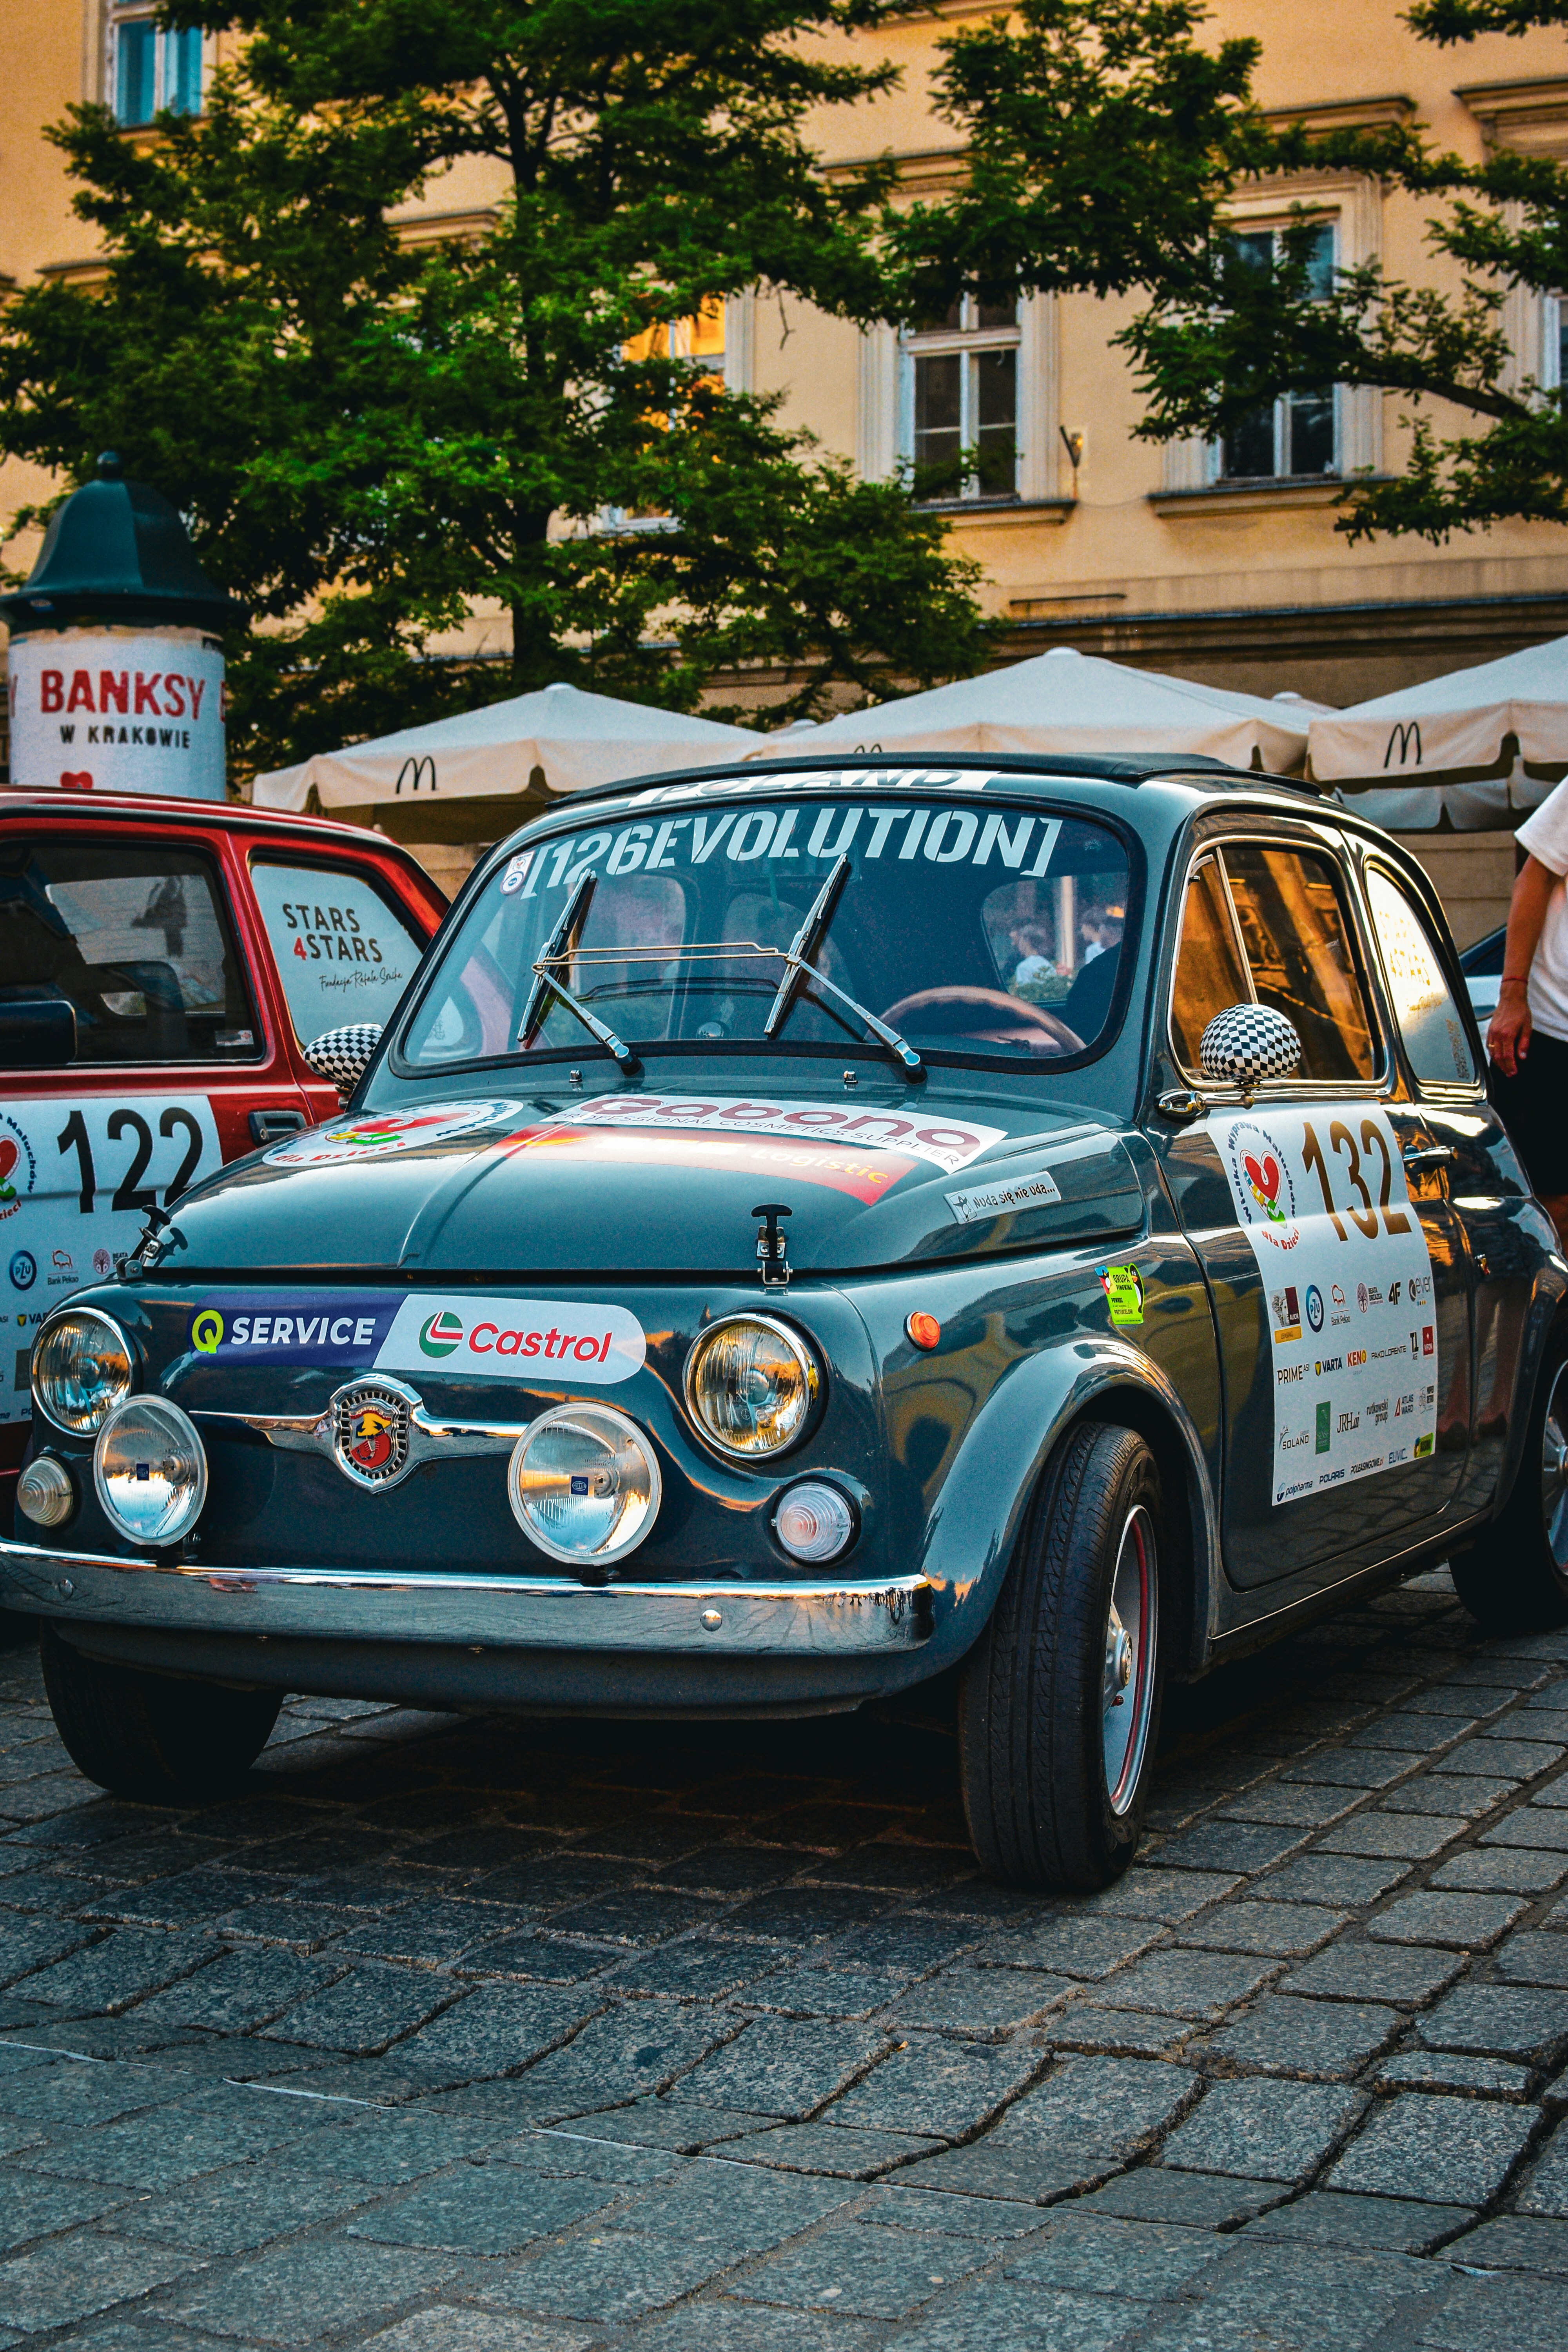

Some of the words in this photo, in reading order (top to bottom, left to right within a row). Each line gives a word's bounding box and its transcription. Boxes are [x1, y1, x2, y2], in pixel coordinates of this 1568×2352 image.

[41, 670, 205, 720] BANKSY
[60, 725, 75, 744] W
[88, 726, 190, 749] KRAKOWIE
[282, 903, 360, 933] STARS
[293, 934, 382, 963] 4STARS
[580, 1098, 980, 1157] Gabona
[1228, 1122, 1259, 1151] Wyprawa
[552, 1114, 711, 1125] PROFESSIONAL
[719, 1120, 849, 1136] COSMETICS
[849, 1133, 959, 1166] SUPPLIER
[57, 1107, 203, 1213] 122
[751, 1149, 889, 1184] Logistic
[1232, 1157, 1252, 1225] Wielka
[1301, 1119, 1412, 1242] 132
[973, 1194, 998, 1209] Nuda
[998, 1191, 1016, 1205] się
[1014, 1187, 1029, 1199] nie
[1261, 1230, 1279, 1248] dla
[1280, 1227, 1300, 1250] Dzieci
[16, 1263, 31, 1279] PZU
[48, 1276, 61, 1285] Bank
[62, 1275, 79, 1284] Pekao
[1113, 1274, 1130, 1283] GRUPA
[1388, 1281, 1401, 1305] 4F
[1310, 1299, 1320, 1319] PZU
[1331, 1316, 1340, 1326] Bank
[1340, 1314, 1350, 1324] Pekao
[192, 1310, 224, 1354] Q
[232, 1317, 376, 1345] SERVICE
[468, 1323, 612, 1363] Castrol
[1322, 1357, 1343, 1373] VARTA
[1347, 1350, 1367, 1367] KENO
[1277, 1365, 1303, 1385] PRIME
[1367, 1398, 1388, 1415] rutkowski
[1402, 1394, 1414, 1404] ATLAS
[1375, 1412, 1388, 1426] group
[1283, 1435, 1308, 1450] SOLAND
[1319, 1469, 1345, 1484] POLARIS
[1285, 1481, 1313, 1497] polpharma
